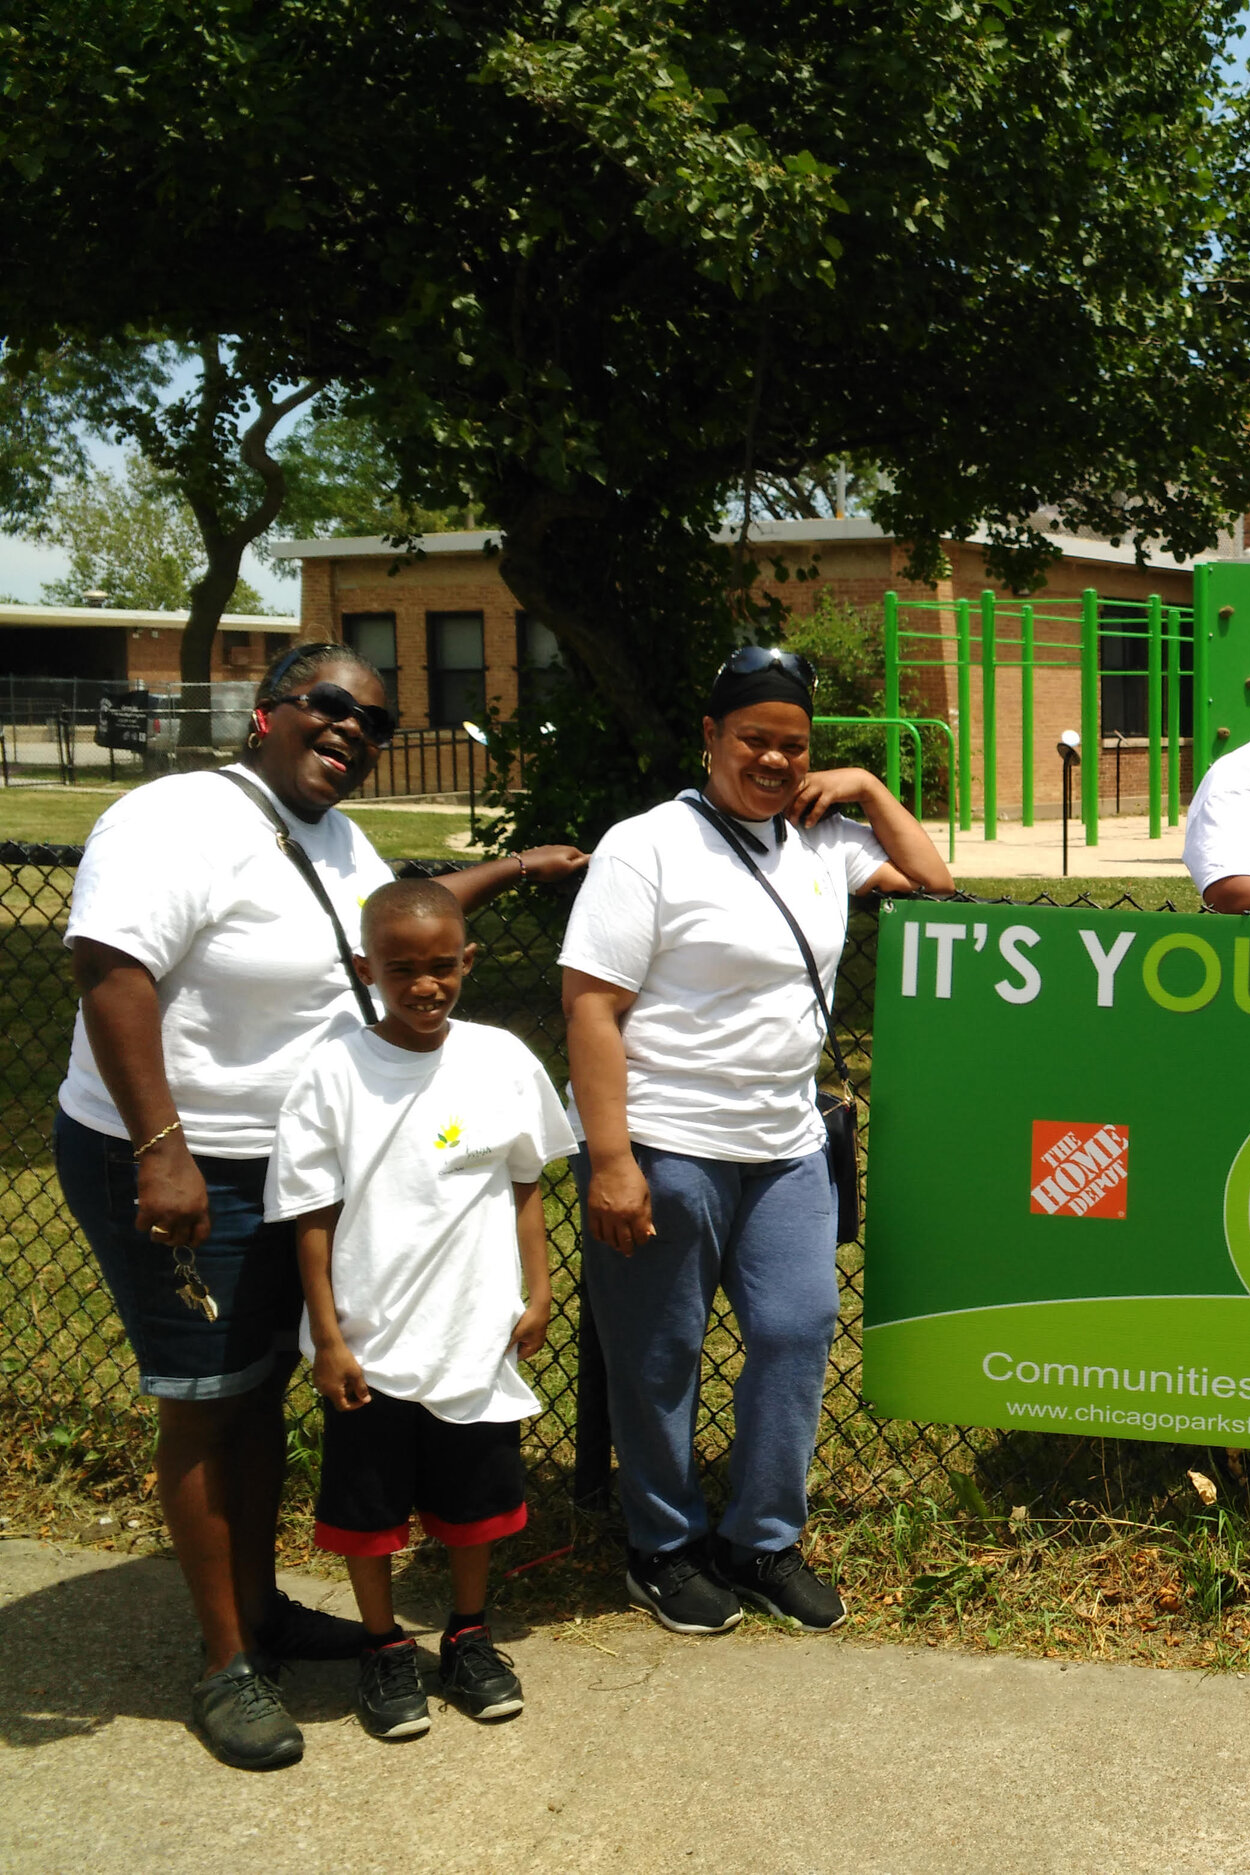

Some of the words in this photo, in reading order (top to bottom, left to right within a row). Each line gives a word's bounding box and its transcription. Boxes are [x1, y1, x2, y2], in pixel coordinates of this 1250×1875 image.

[902, 922, 1042, 1004] IT'S
[1031, 1124, 1129, 1215] HOME
[1040, 1131, 1082, 1168] THE
[1068, 1159, 1128, 1217] DEPOT
